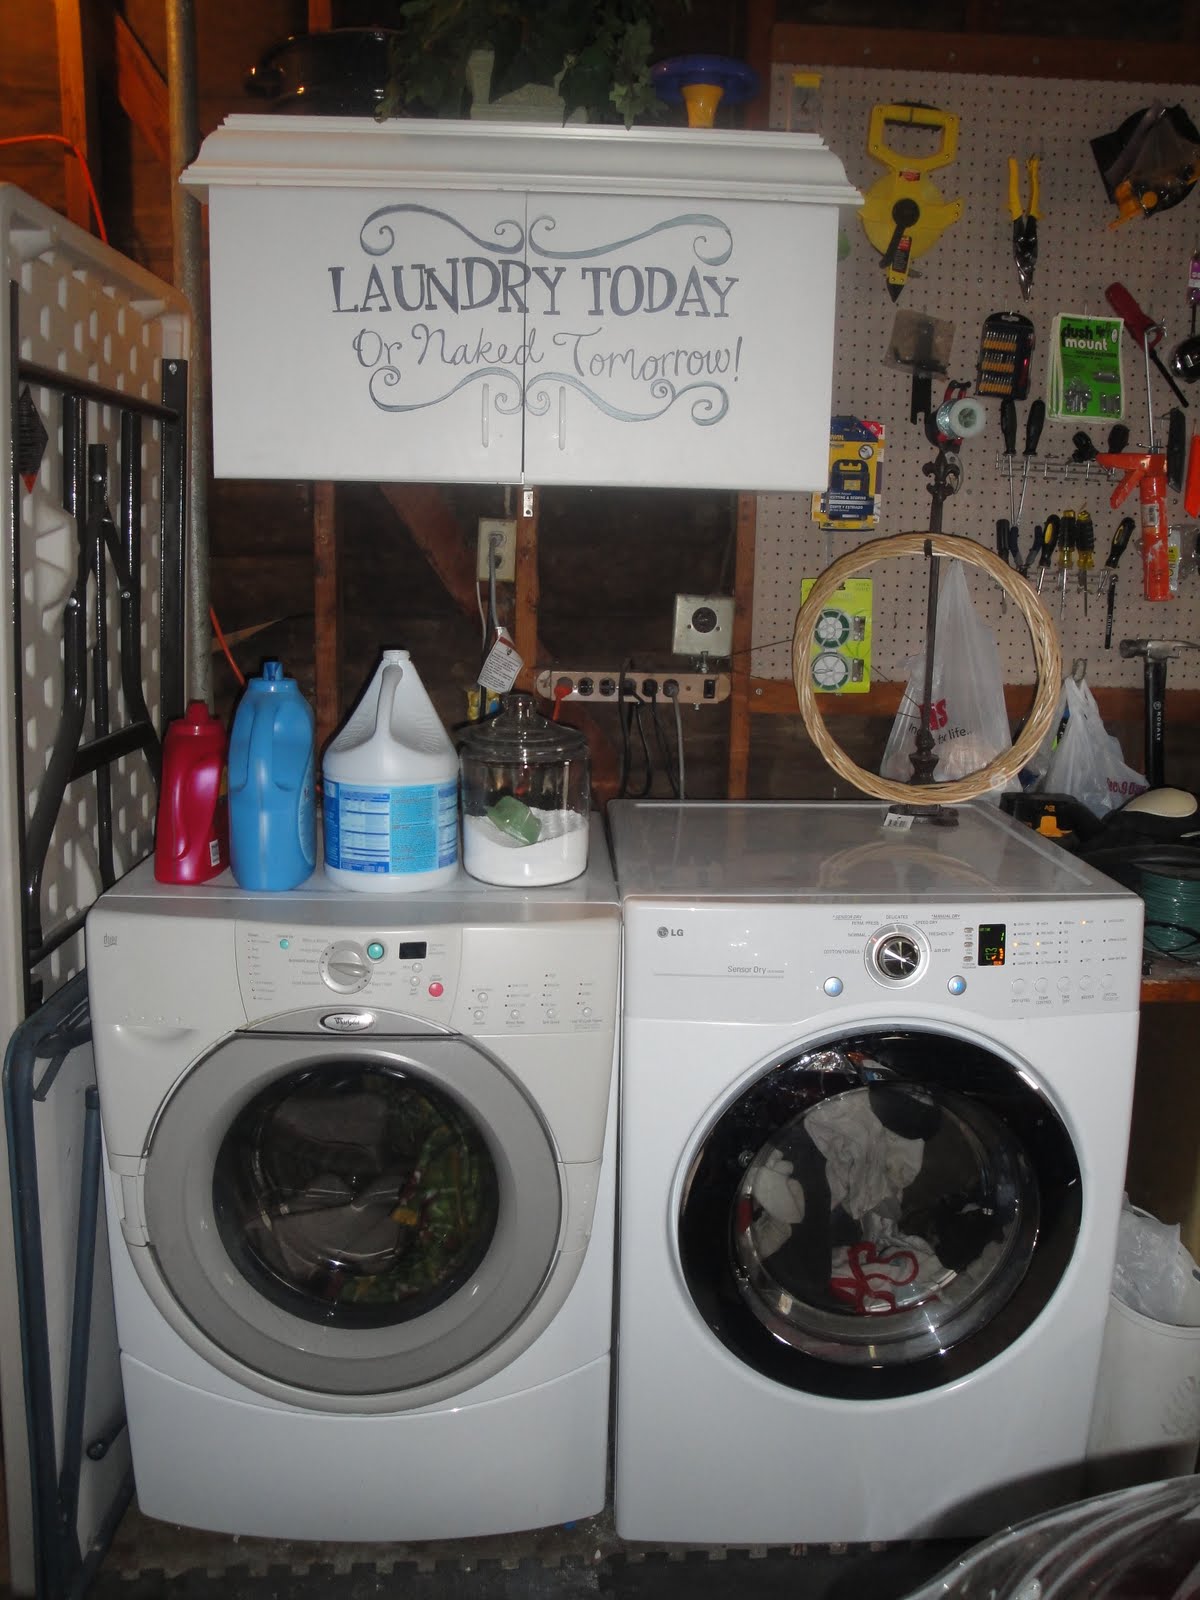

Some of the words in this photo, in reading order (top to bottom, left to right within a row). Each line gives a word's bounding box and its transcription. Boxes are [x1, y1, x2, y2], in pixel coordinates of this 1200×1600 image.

[328, 257, 565, 316] LAUNDRY
[581, 265, 739, 318] TODAY
[352, 329, 402, 368] Or
[411, 322, 544, 366] Naked
[553, 326, 744, 383] Tomorrow!
[1065, 337, 1108, 351] mount
[727, 965, 752, 973] Sensor
[753, 965, 767, 974] Dry
